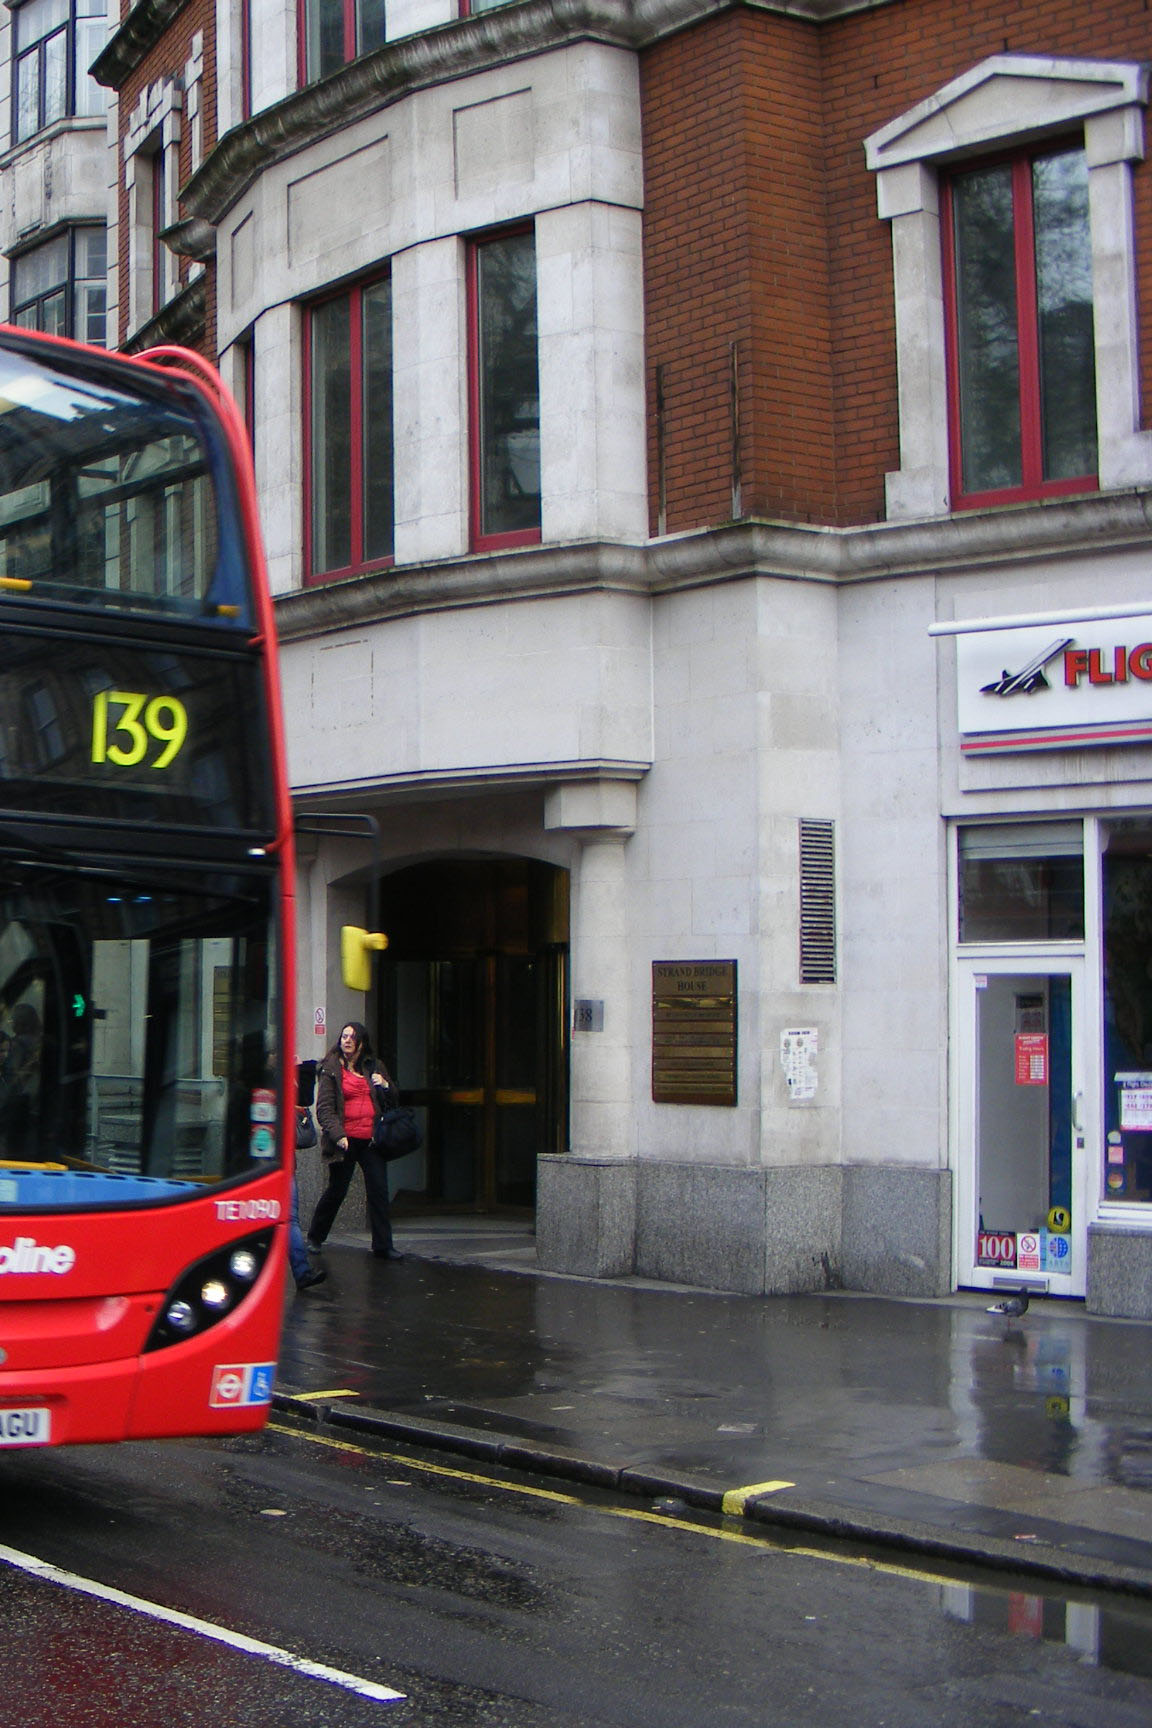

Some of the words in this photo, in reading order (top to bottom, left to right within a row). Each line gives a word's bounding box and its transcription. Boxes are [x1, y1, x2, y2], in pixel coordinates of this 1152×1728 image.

[91, 690, 188, 769] 139
[657, 967, 692, 977] STRAND
[695, 966, 727, 977] BRIDGE
[677, 981, 706, 991] HOUSE
[213, 1199, 281, 1220] TE1090
[978, 1235, 1014, 1260] 100
